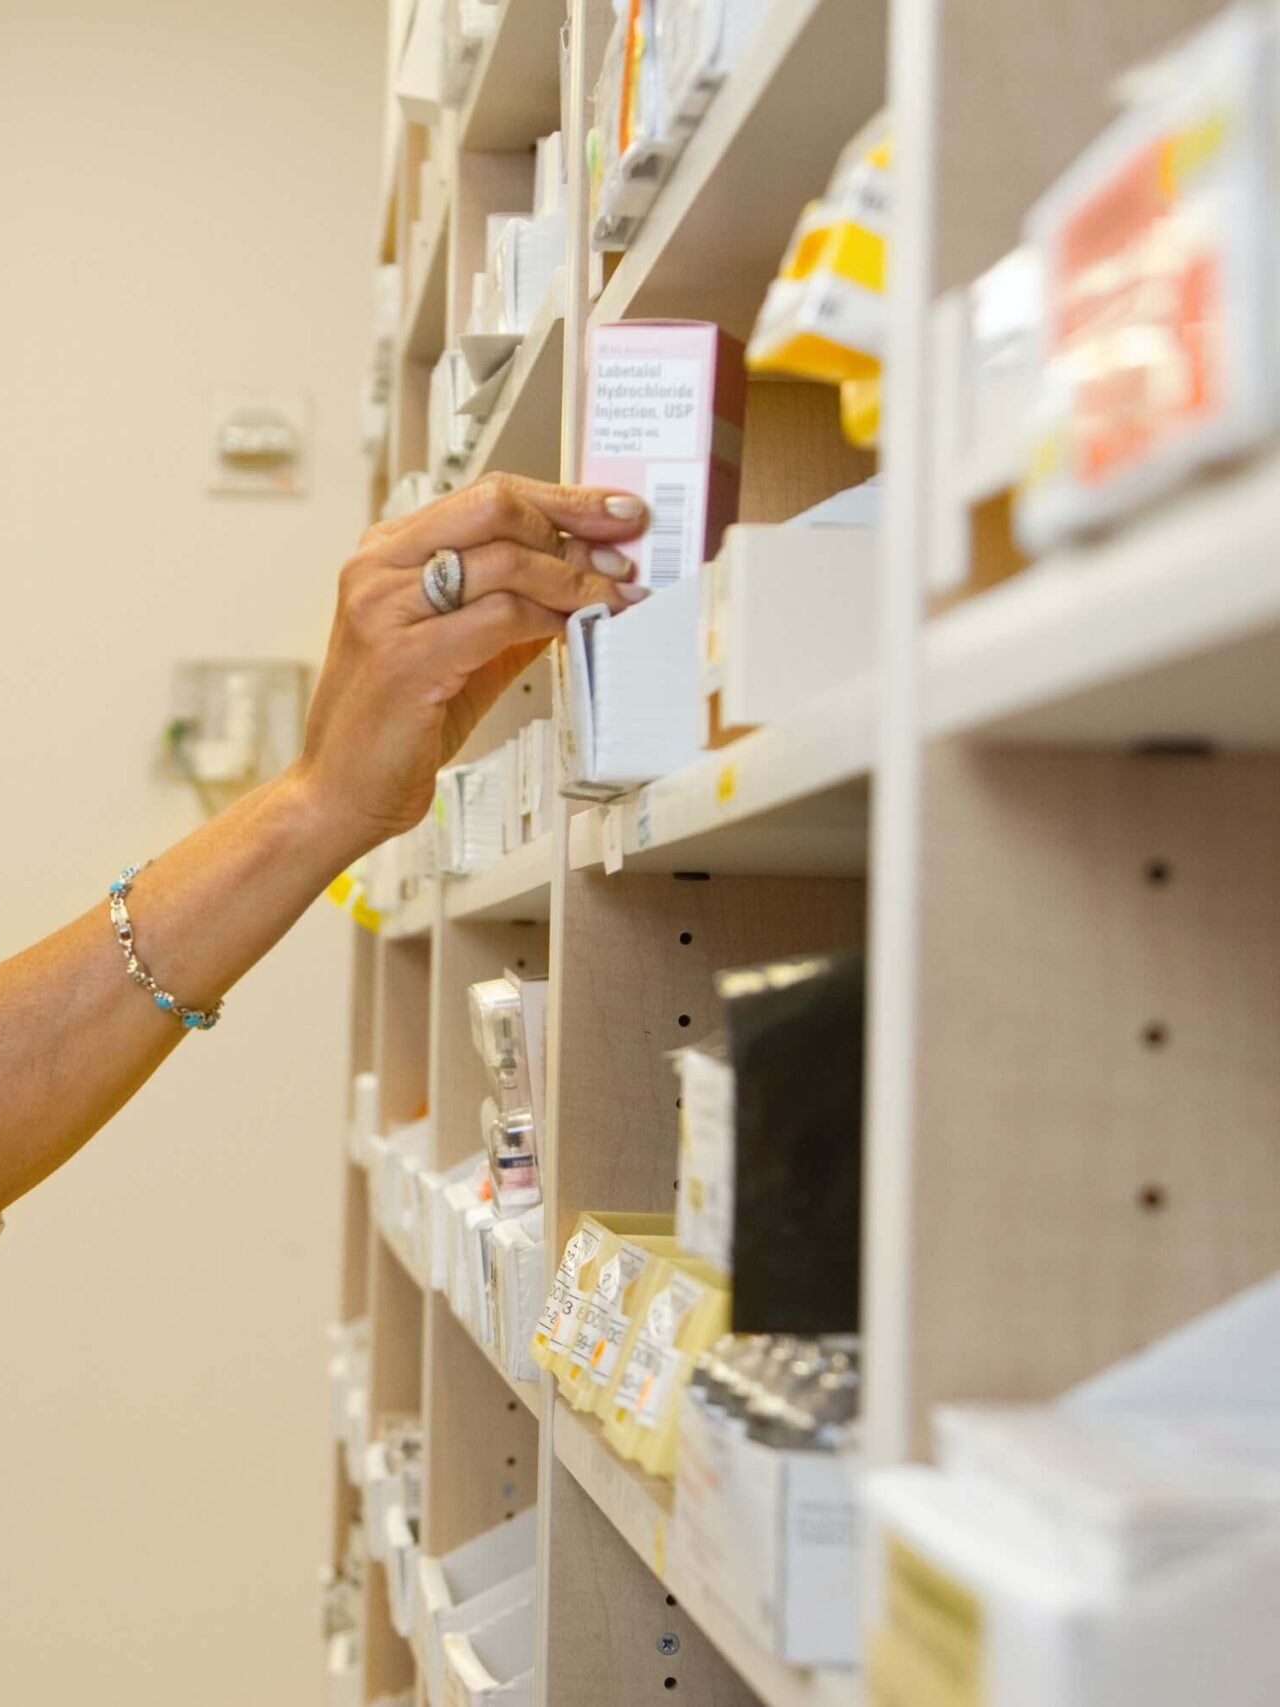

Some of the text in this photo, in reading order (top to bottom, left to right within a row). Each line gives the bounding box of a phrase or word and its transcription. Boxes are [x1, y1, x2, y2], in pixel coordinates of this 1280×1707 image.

[597, 363, 662, 378] Labetalol
[596, 383, 695, 400] Hydrochloride
[595, 402, 694, 421] Injection, USP
